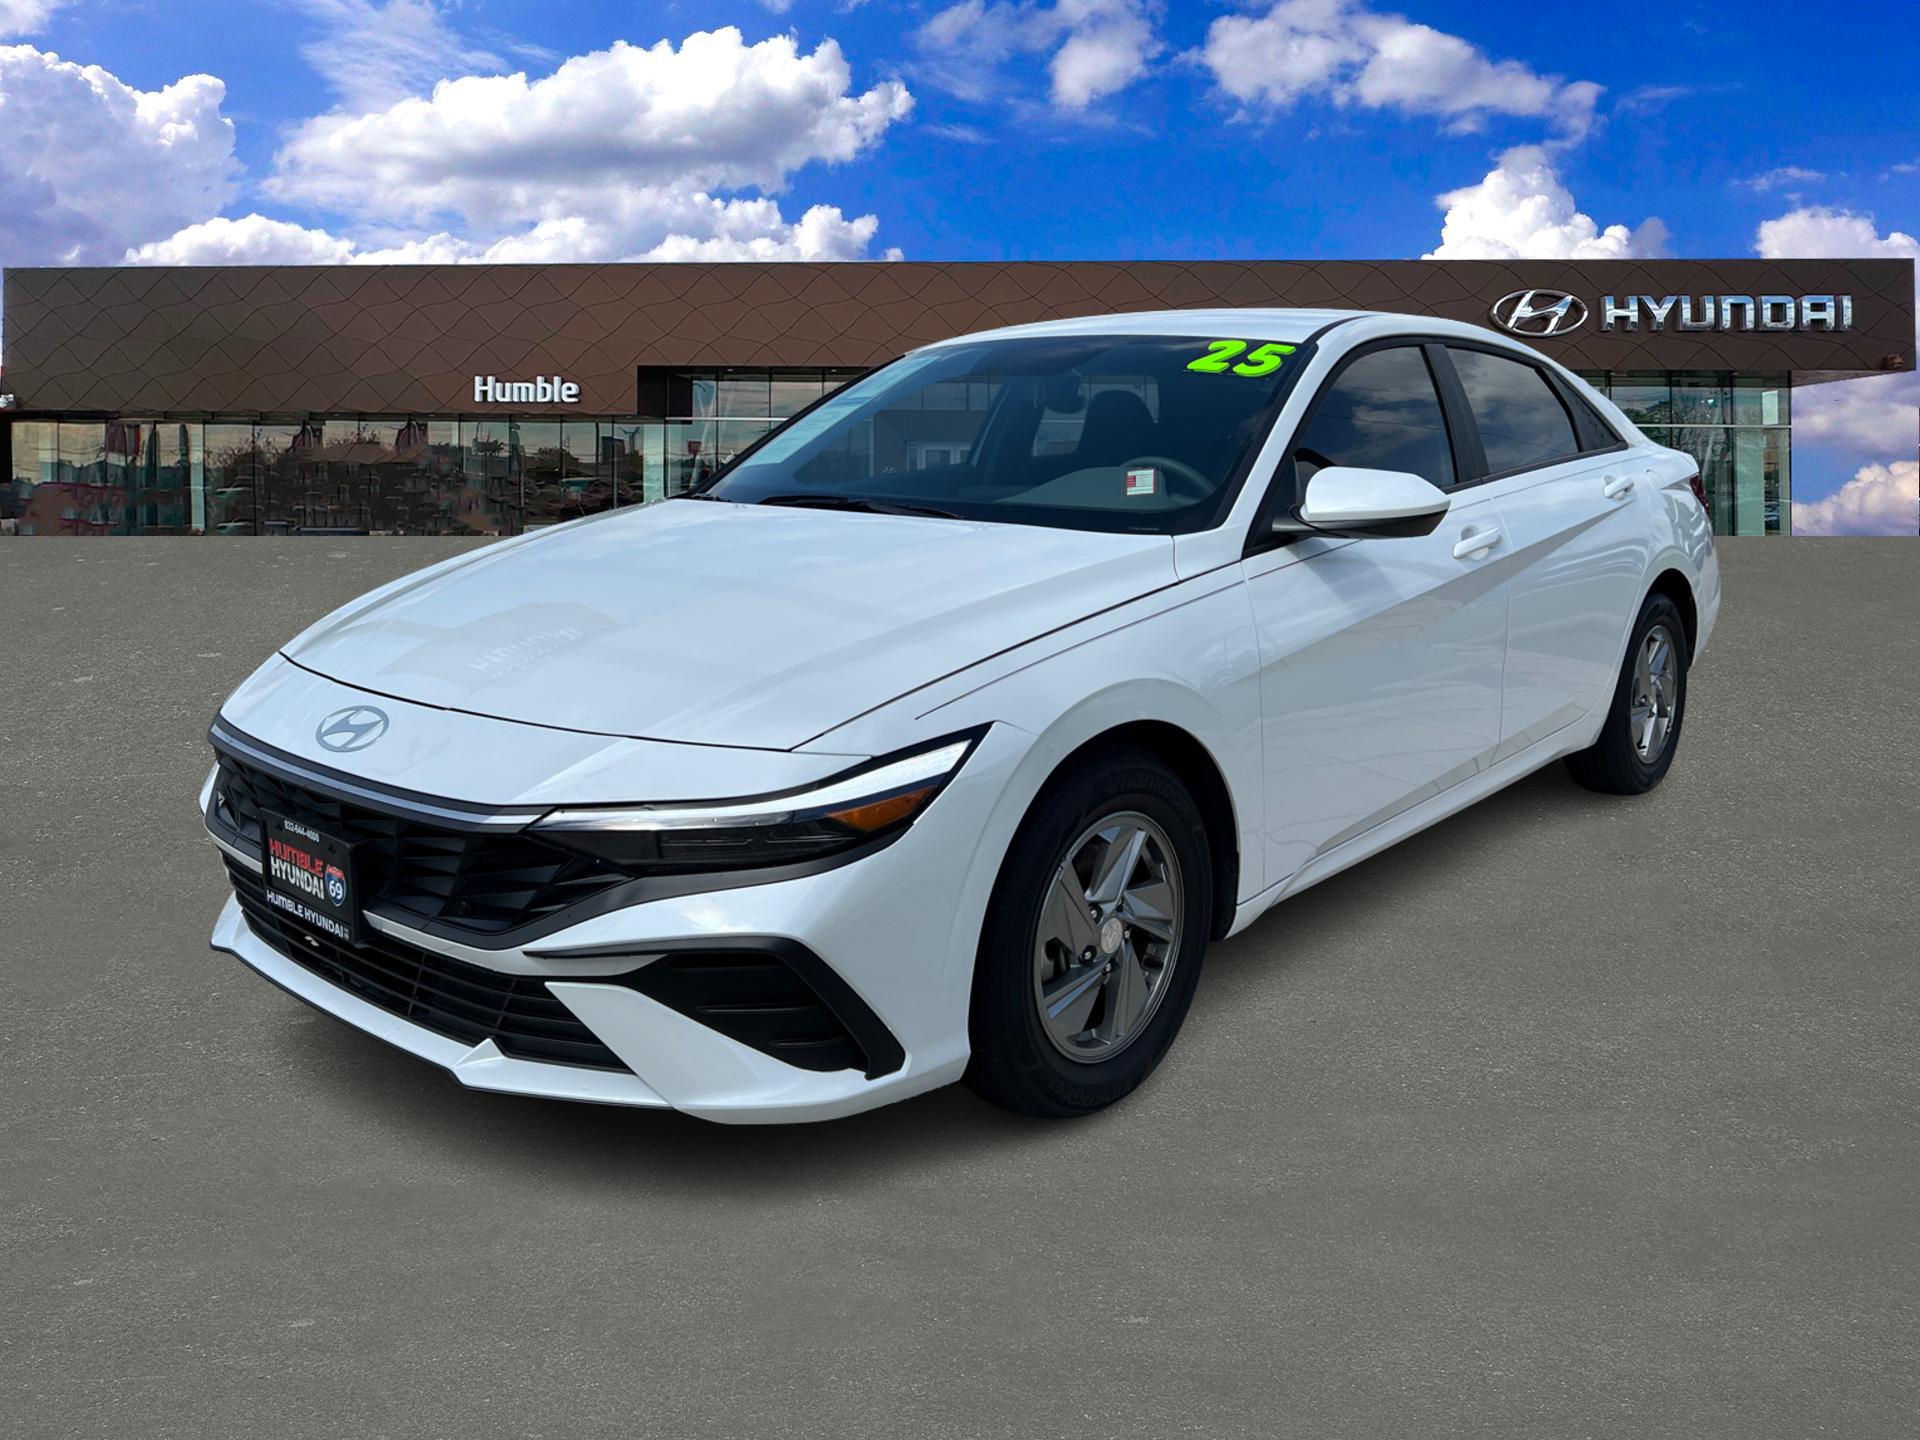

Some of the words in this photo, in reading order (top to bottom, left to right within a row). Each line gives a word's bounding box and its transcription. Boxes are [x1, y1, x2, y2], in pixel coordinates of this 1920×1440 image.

[1602, 294, 1853, 332] HYUNDAI
[1186, 340, 1297, 377] 25
[474, 375, 580, 403] Humble
[270, 855, 325, 900] HYUNDAI
[328, 880, 344, 900] 69
[304, 907, 344, 938] HYUNDAI
